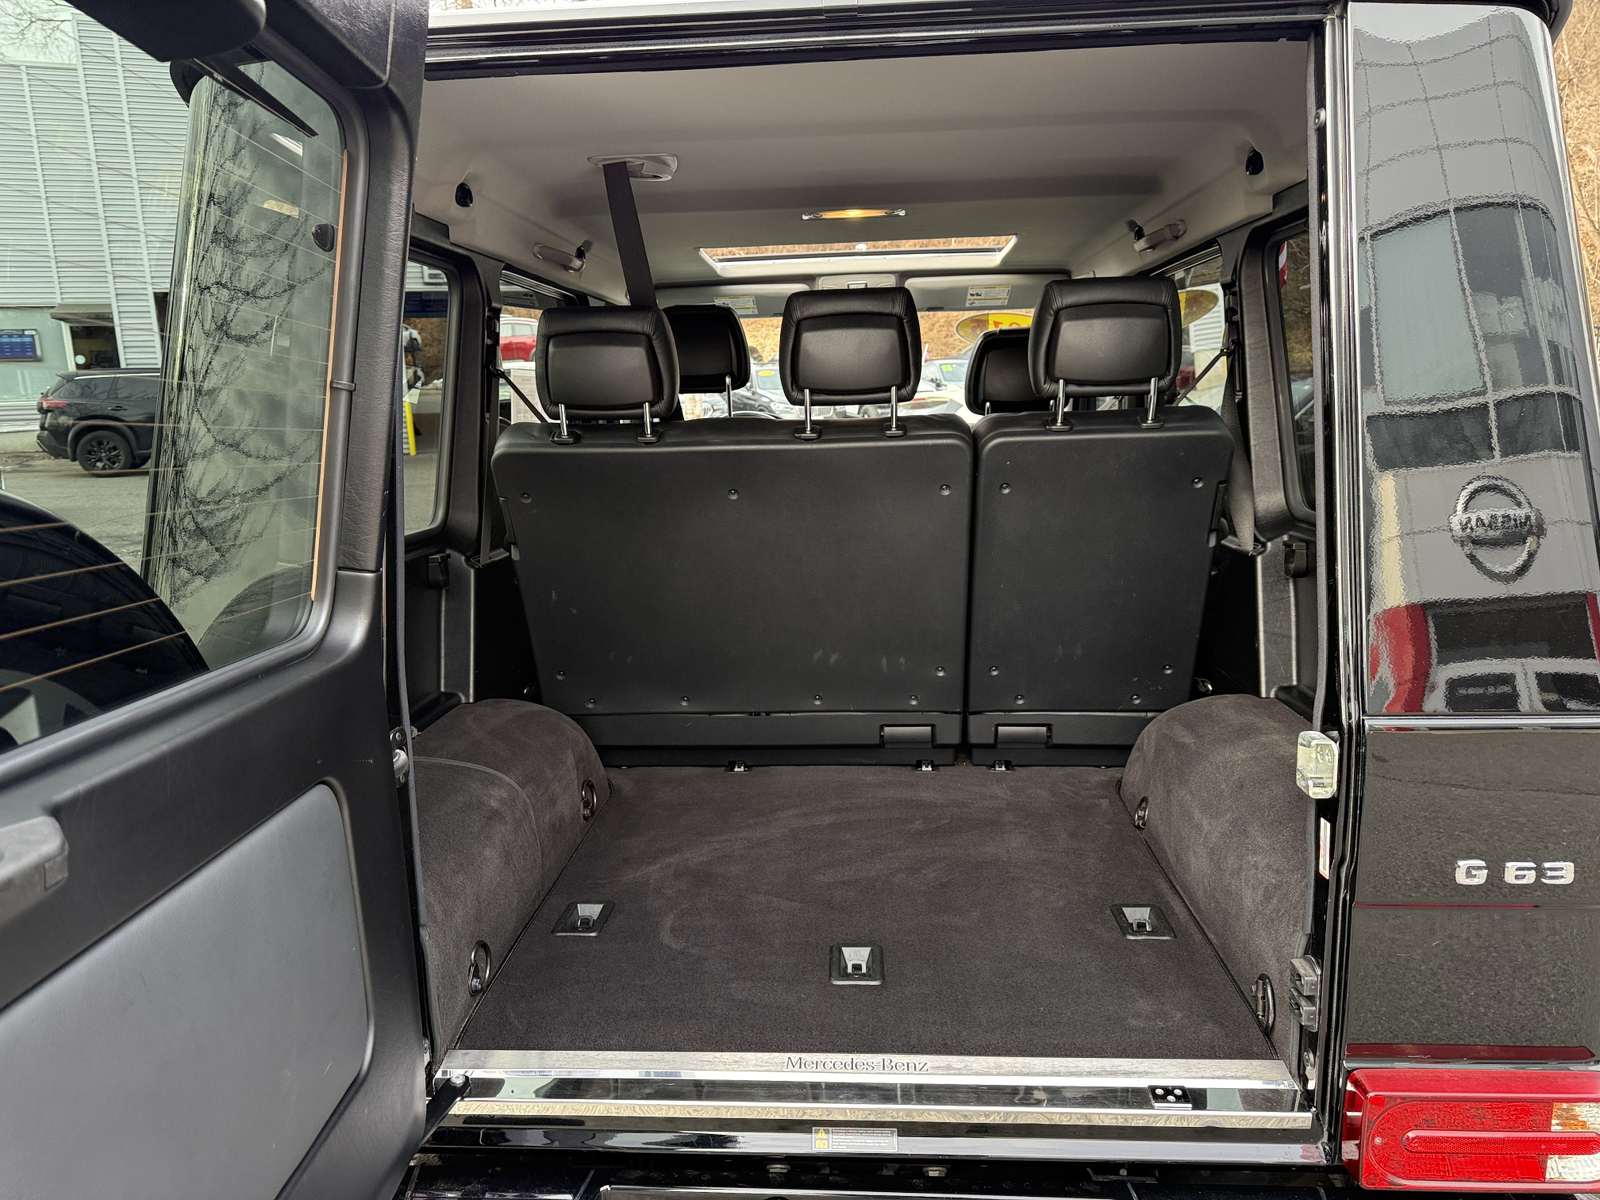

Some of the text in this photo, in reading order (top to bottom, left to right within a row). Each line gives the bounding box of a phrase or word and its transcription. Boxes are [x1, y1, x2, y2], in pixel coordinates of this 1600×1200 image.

[1455, 859, 1575, 885] G 63
[785, 1056, 929, 1072] Mercedes-Benz
